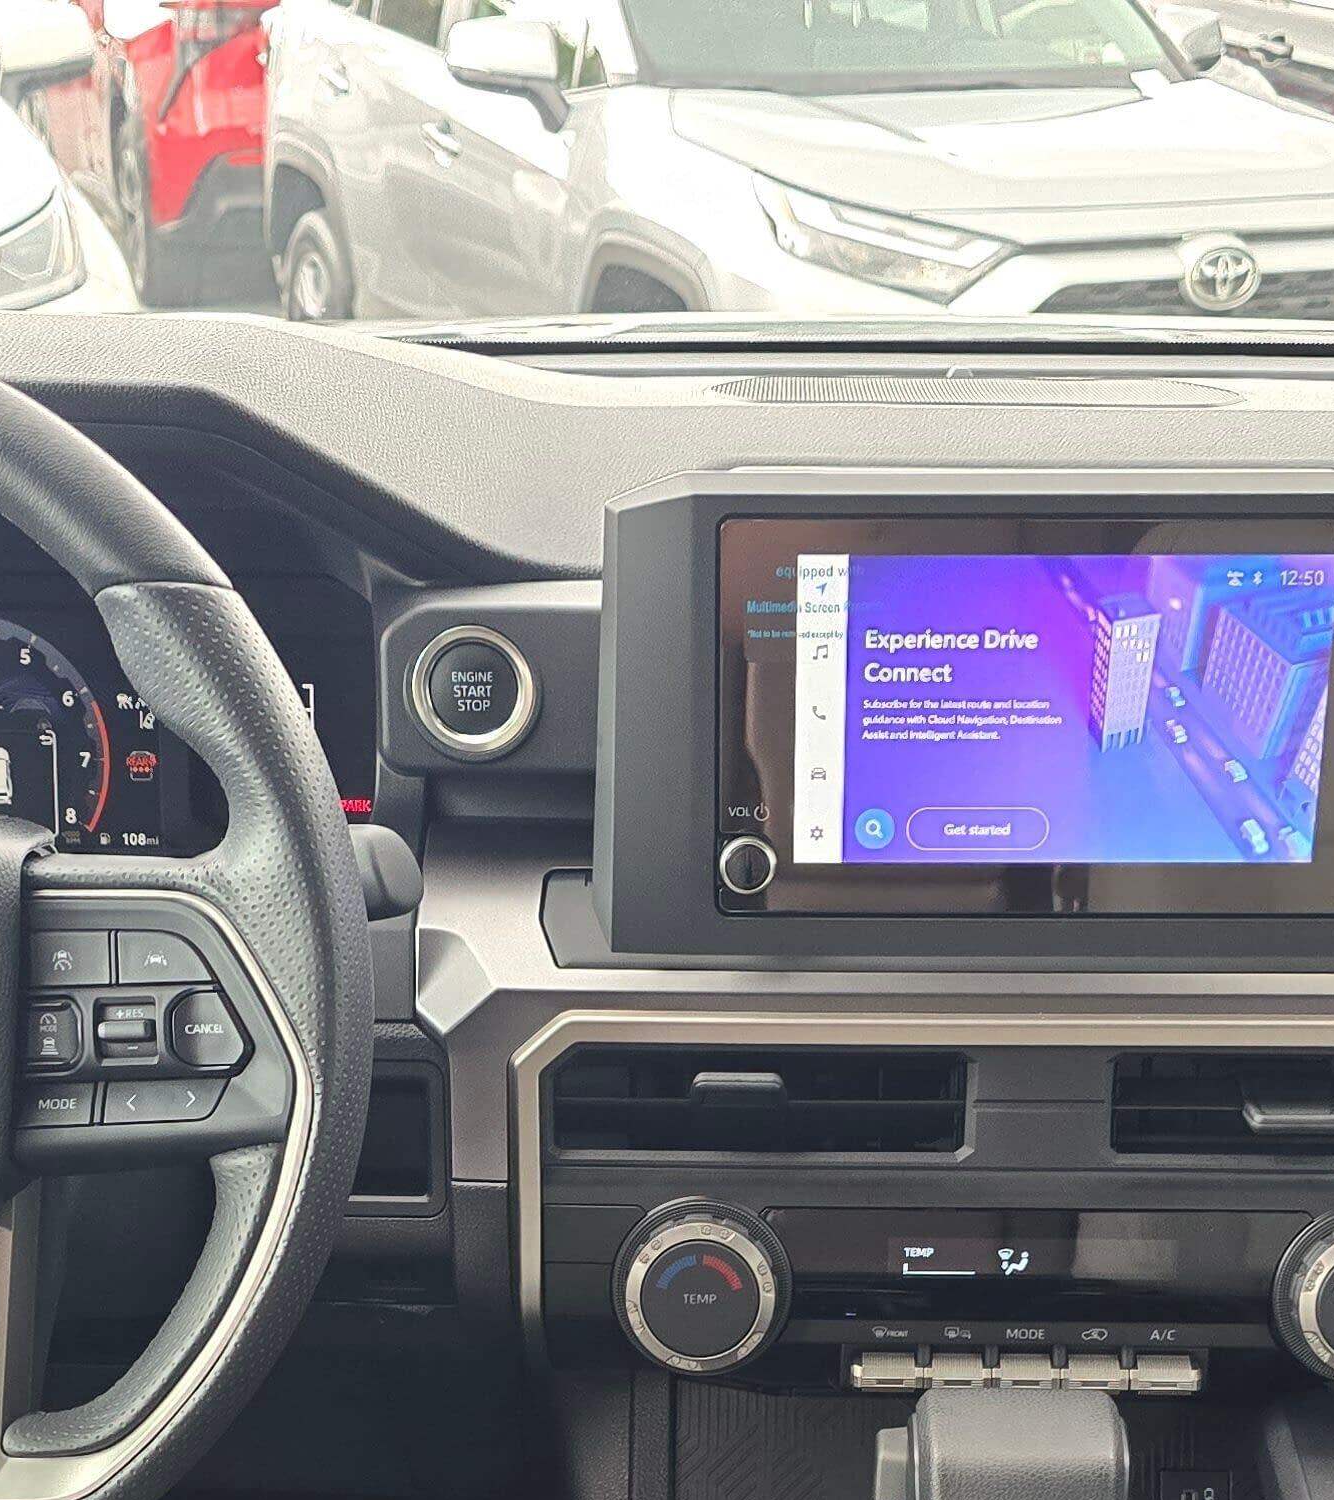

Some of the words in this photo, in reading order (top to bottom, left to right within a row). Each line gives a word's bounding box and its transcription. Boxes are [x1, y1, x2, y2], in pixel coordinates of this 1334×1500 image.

[1280, 570, 1325, 586] 12:50
[865, 627, 980, 653] Experience
[984, 627, 1039, 650] Drive
[20, 648, 31, 665] 5
[451, 671, 493, 682] ENGINE
[864, 662, 953, 683] Connect
[453, 685, 493, 698] START
[62, 690, 74, 707] 6
[863, 699, 907, 709] Subscribe
[909, 699, 922, 709] for
[924, 699, 939, 709] the
[993, 699, 1012, 710] and
[1013, 699, 1050, 710] location
[457, 700, 491, 711] STOP
[862, 714, 906, 726] guidance
[907, 714, 927, 725] with
[928, 714, 955, 725] Cloud
[1010, 715, 1063, 726] Destination
[79, 751, 91, 768] 7
[339, 799, 372, 813] PARK
[728, 806, 751, 817] VOL
[65, 807, 77, 824] 8
[943, 823, 966, 836] Get
[968, 822, 1011, 836] started
[184, 1023, 224, 1034] CANCEL
[38, 1098, 77, 1110] MODE
[903, 1247, 934, 1258] TEMP
[683, 1293, 717, 1305] TEMP
[886, 1330, 909, 1338] FRONT
[1006, 1328, 1046, 1341] MODE
[1150, 1328, 1176, 1342] A/C
